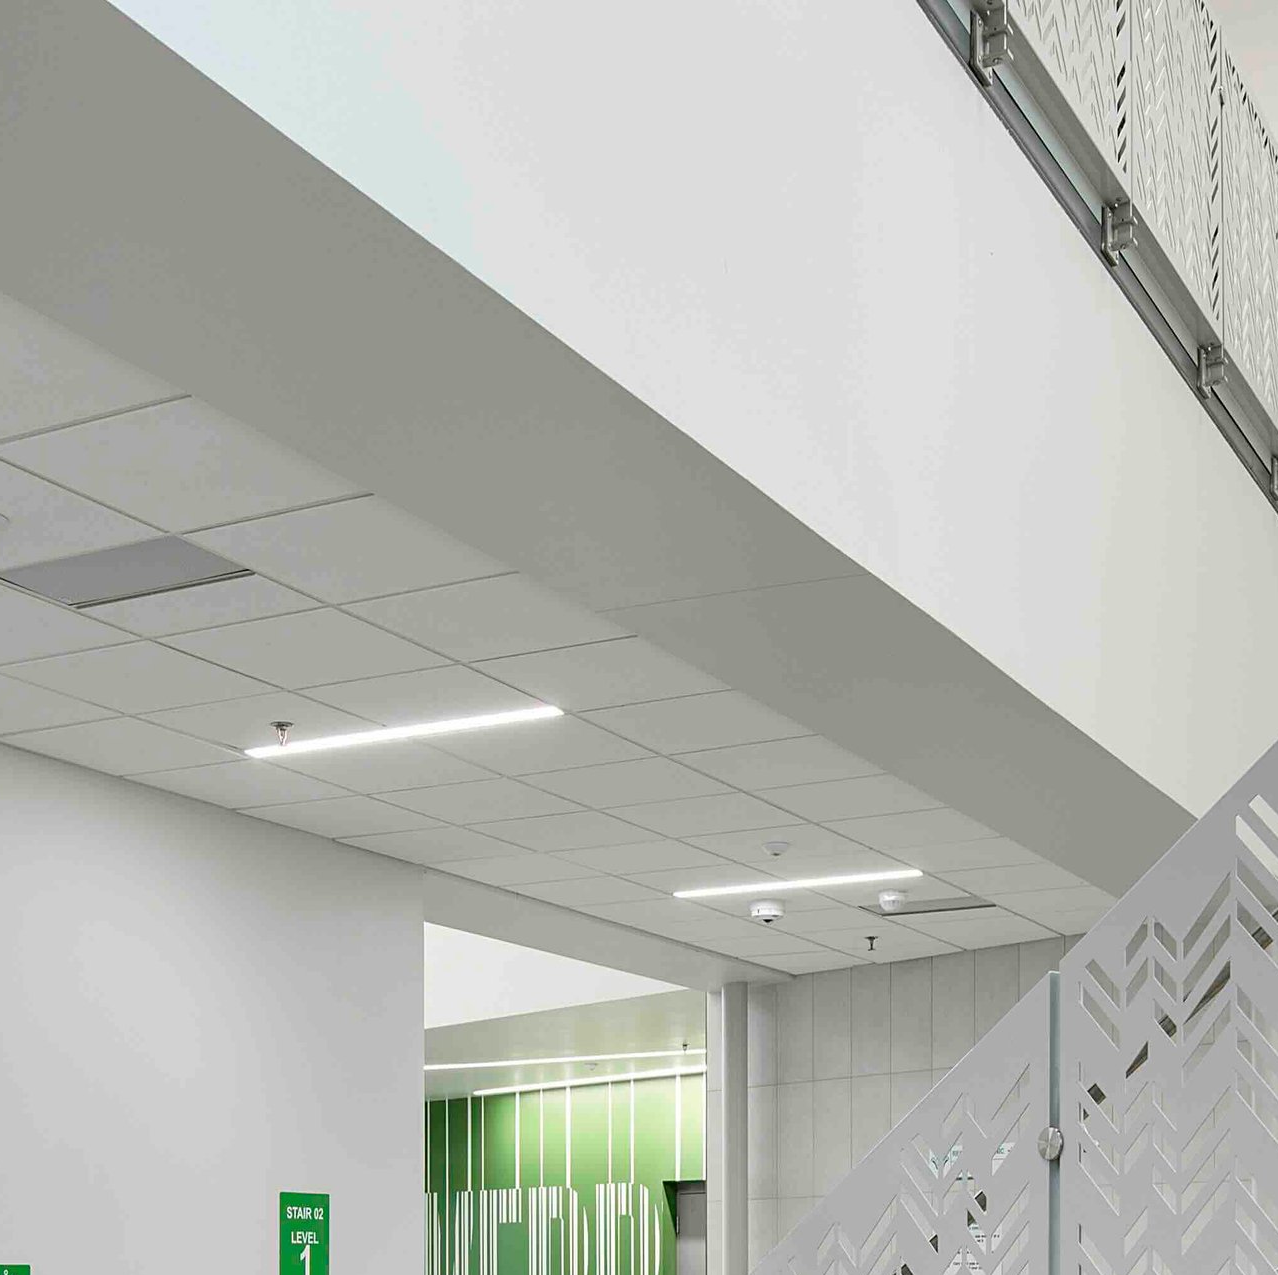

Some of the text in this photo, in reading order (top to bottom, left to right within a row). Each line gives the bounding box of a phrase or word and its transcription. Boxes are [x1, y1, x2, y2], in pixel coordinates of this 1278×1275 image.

[286, 1206, 324, 1220] STAIR 02
[291, 1231, 319, 1244] LEVEL
